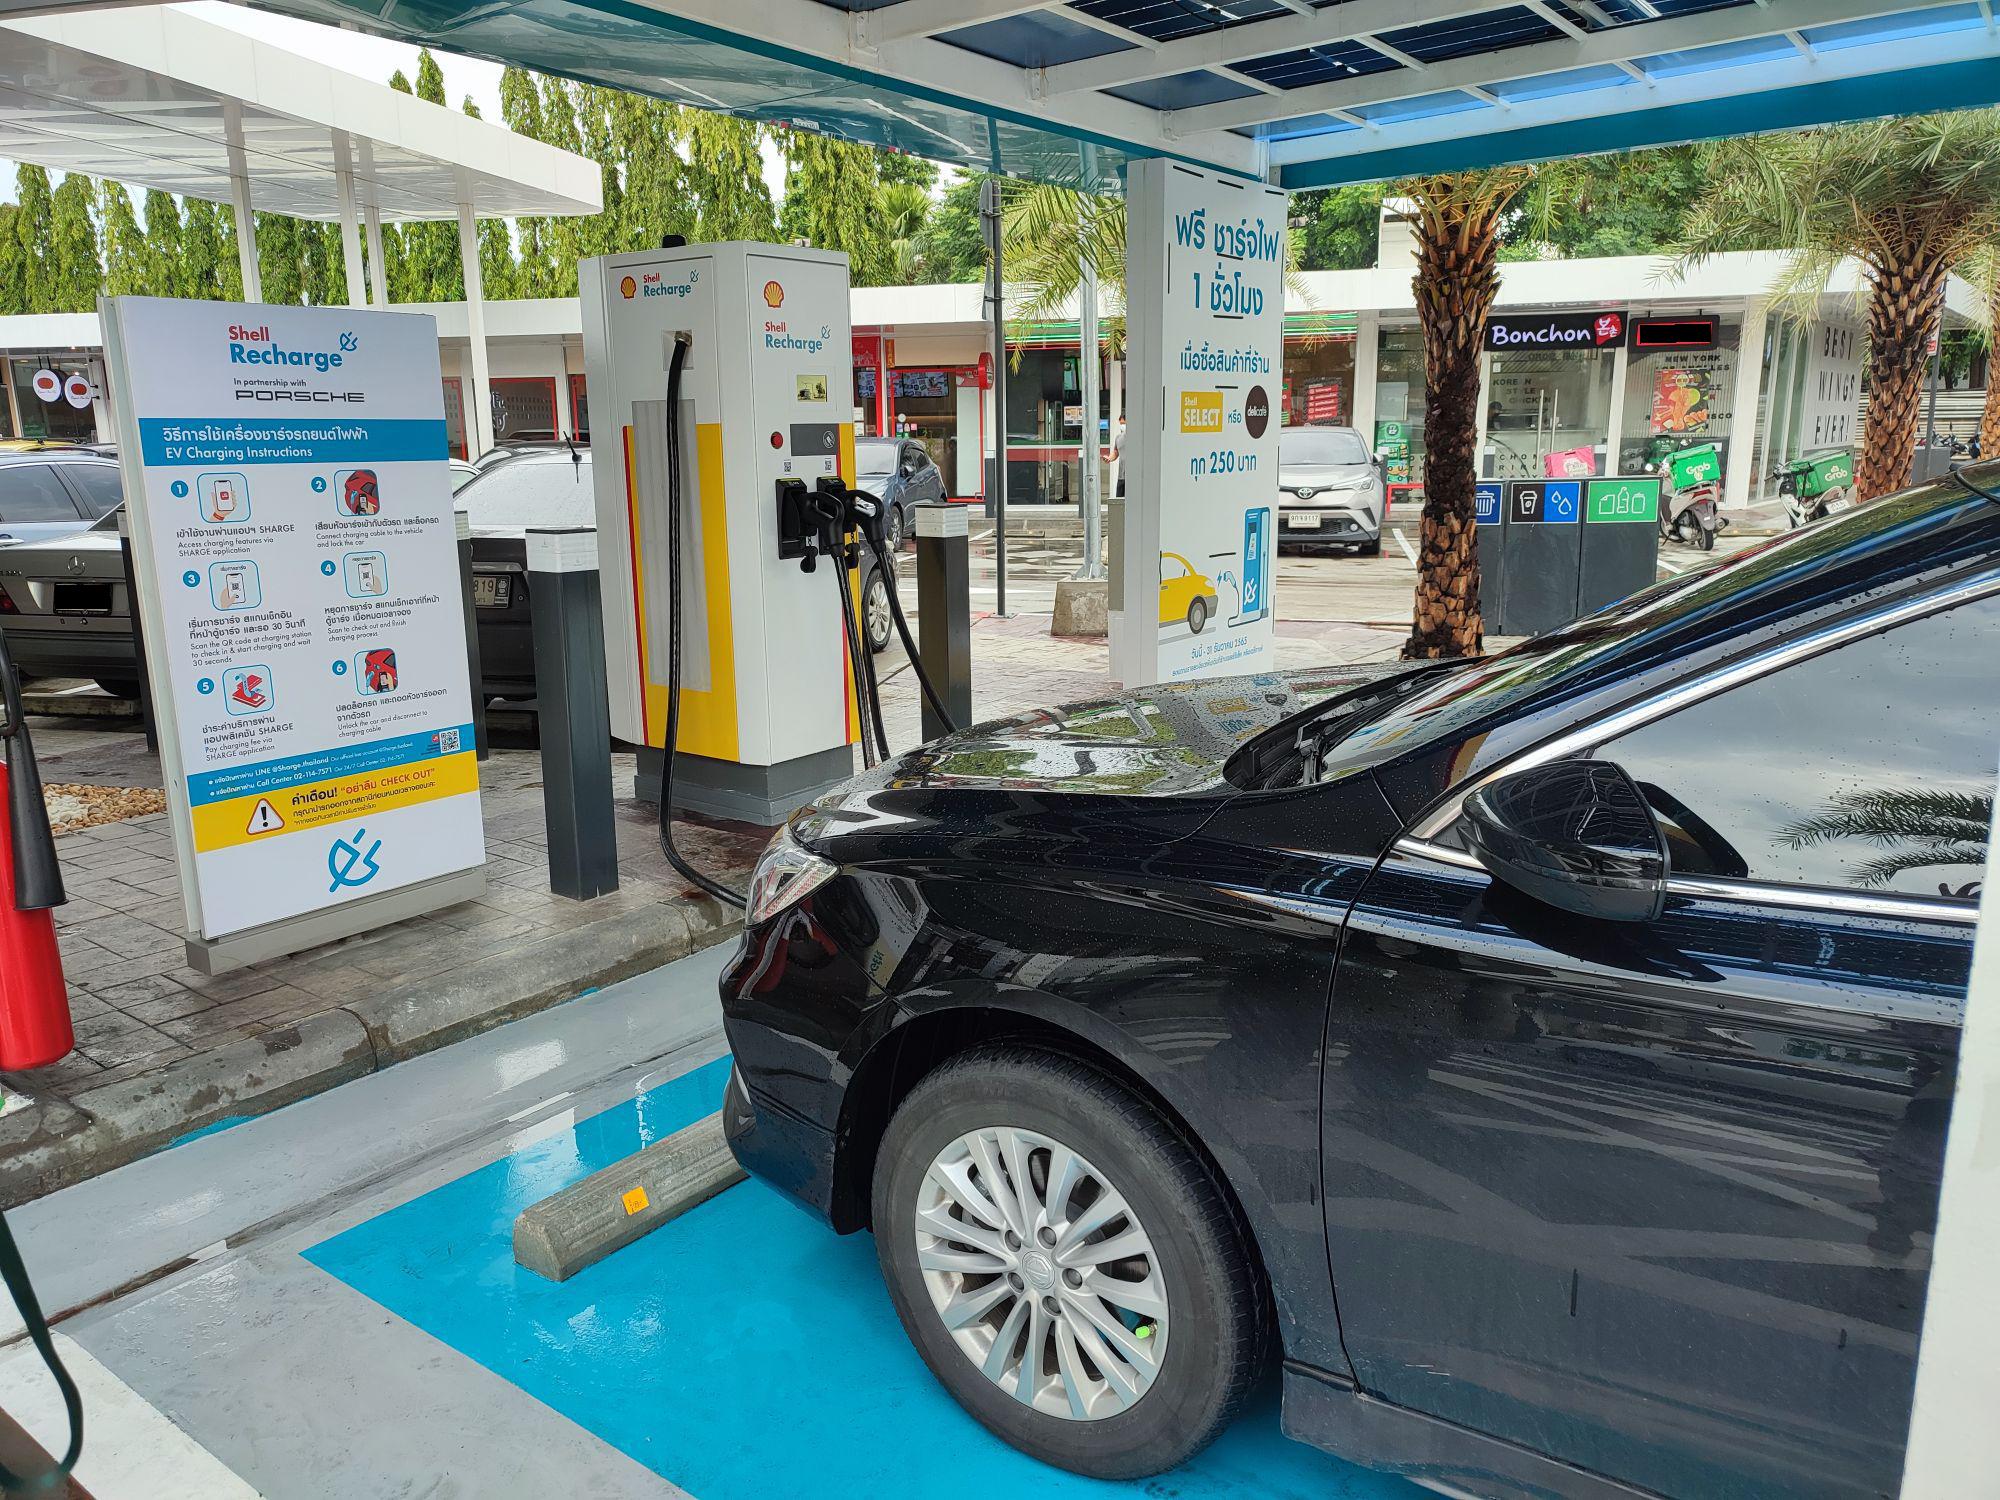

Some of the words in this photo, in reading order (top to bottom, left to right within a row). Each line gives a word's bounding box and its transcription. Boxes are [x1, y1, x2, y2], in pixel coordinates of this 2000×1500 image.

[1176, 208, 1205, 250] ฟรี
[1215, 218, 1279, 262] ชาร์จไฟ
[643, 273, 660, 283] Shell
[643, 282, 691, 297] Recharge
[1194, 273, 1200, 308] 1
[1211, 262, 1263, 315] ชั่วโมง
[229, 325, 269, 341] Shell
[765, 322, 786, 333] Shell
[1492, 324, 1590, 345] Bonchon
[765, 334, 822, 354] Recharge
[1824, 327, 1854, 360] BEST
[230, 343, 342, 372] Recharge
[1180, 341, 1269, 374] เมื่อซื้อสินค้าที่ร้าน
[1693, 354, 1721, 362] YORK
[244, 378, 288, 388] partnership
[291, 379, 306, 387] with
[1493, 378, 1532, 386] KOREN
[1819, 370, 1855, 402] WINGS
[235, 390, 365, 402] PORSCHE
[1185, 397, 1197, 406] Shell
[1184, 408, 1220, 426] SELECT
[1228, 409, 1241, 423] หรือ
[162, 424, 368, 442] วิธีการใช้เครื่องชาร์จรถยนต์ไฟฟ้า
[1815, 415, 1849, 444] EVER!
[166, 447, 182, 459] EV
[186, 447, 244, 461] Charging
[247, 446, 312, 457] Instructions
[1191, 457, 1205, 482] ทุก
[1210, 450, 1234, 473] 250
[1238, 454, 1256, 471] บาท
[1686, 462, 1710, 474] Grab
[1825, 468, 1847, 481] Grab
[176, 485, 182, 494] 1
[316, 481, 323, 489] 2
[177, 526, 256, 538] เข้าใช้งานผ่านแอปฯ
[260, 524, 295, 533] SHARGE
[316, 532, 341, 540] Connect
[343, 531, 368, 539] charging
[204, 540, 234, 548] charging
[179, 549, 210, 557] SHARGE
[213, 547, 250, 556] application
[325, 564, 331, 572] 4
[188, 574, 195, 584] 3
[188, 617, 240, 628] เริ่มการชาร์จ
[272, 622, 282, 630] 30
[285, 619, 306, 629] วินาที
[235, 637, 252, 645] code
[262, 634, 290, 642] charging
[291, 631, 312, 639] station
[328, 634, 355, 642] charging
[356, 632, 378, 640] process
[200, 649, 220, 658] check
[253, 642, 282, 651] charging
[205, 657, 232, 665] seconds
[337, 664, 342, 672] 6
[202, 682, 210, 691] 5
[202, 716, 275, 734] ชำระค่าบริการผ่าน
[338, 721, 358, 730] Unlock
[381, 715, 392, 723] and
[393, 711, 421, 720] disconnect
[258, 723, 294, 735] SHARGE
[338, 730, 364, 738] charging
[205, 746, 217, 754] Pay
[220, 742, 249, 751] charging
[251, 738, 261, 746] fee
[206, 750, 237, 762] SHARGE
[239, 745, 275, 756] application
[255, 768, 270, 776] LINE
[257, 778, 269, 787] Call
[271, 775, 292, 785] Center
[292, 787, 337, 806] คำเตือน!
[381, 774, 410, 786] CHECK
